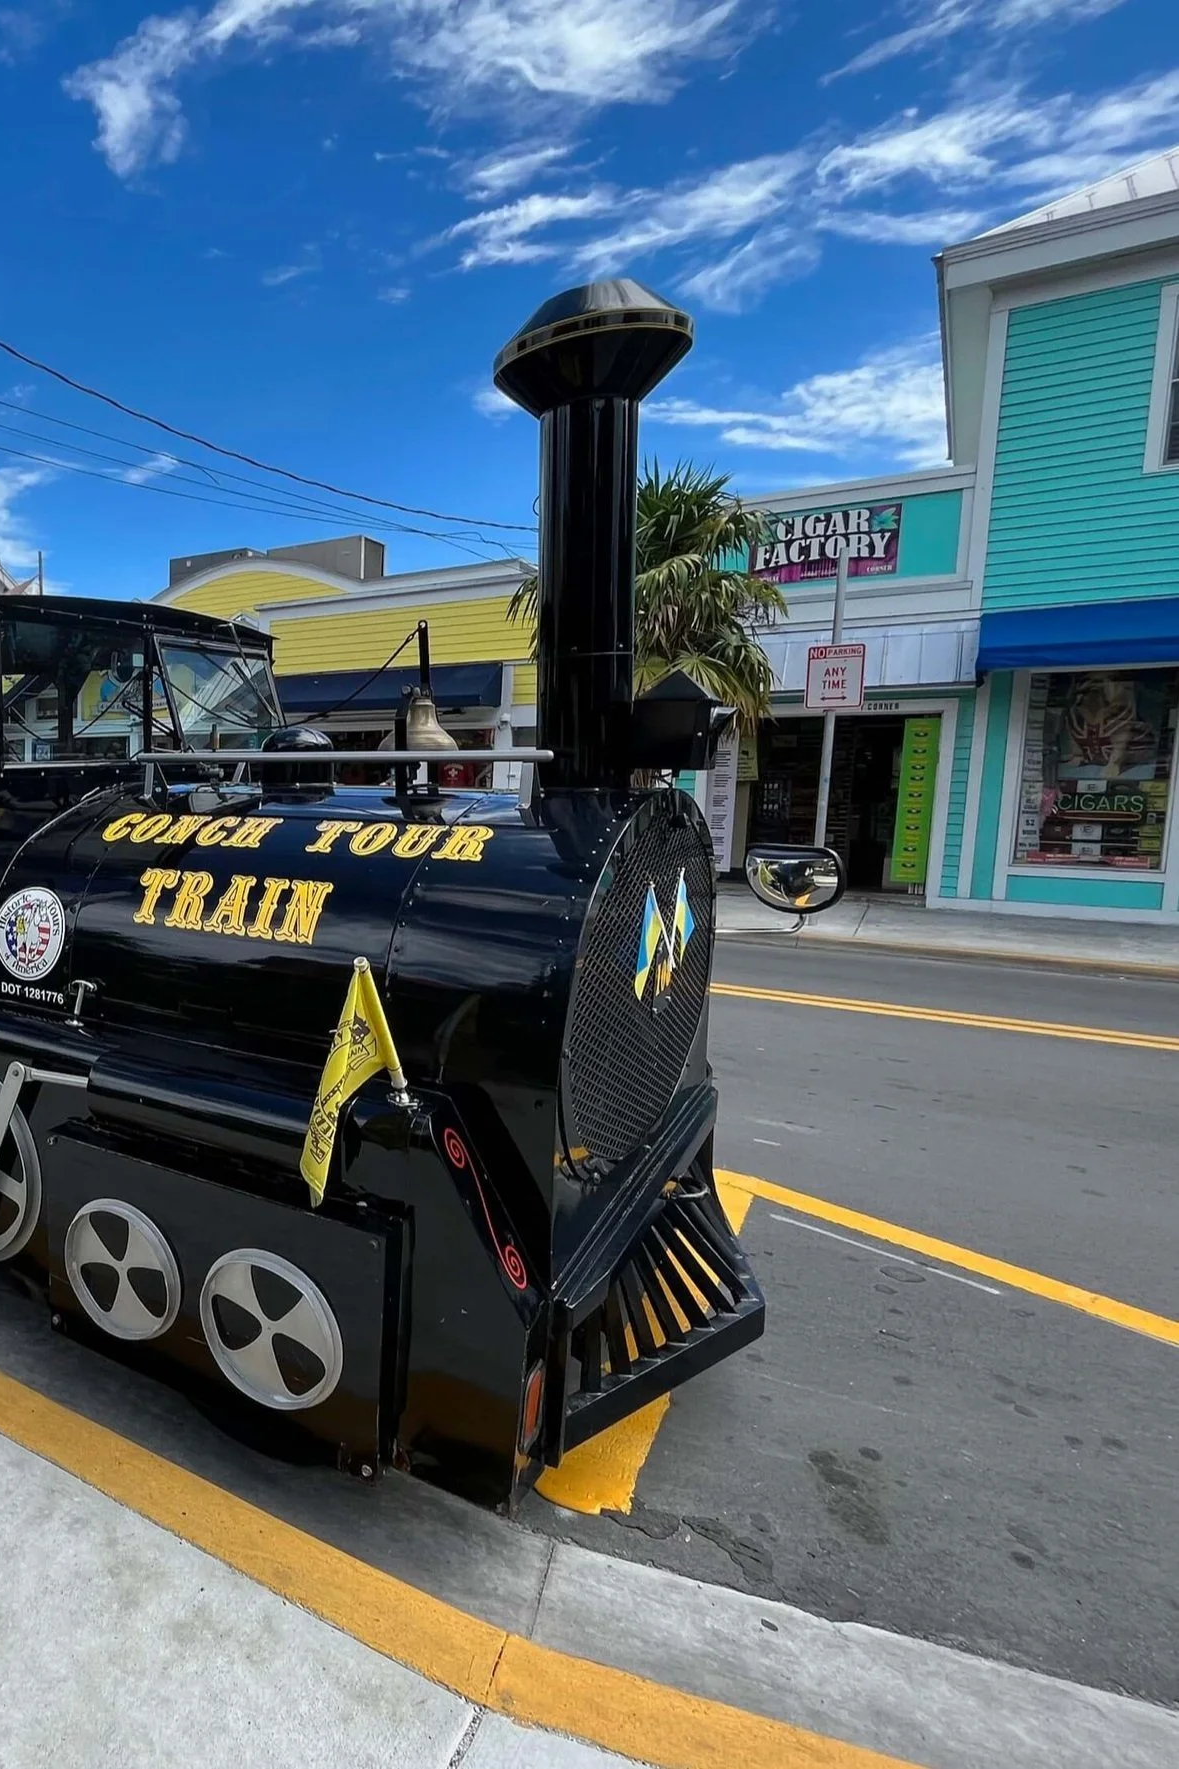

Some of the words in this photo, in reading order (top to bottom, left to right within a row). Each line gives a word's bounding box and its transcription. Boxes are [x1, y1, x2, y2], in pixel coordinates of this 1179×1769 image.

[776, 508, 870, 542] CIGAR
[753, 532, 891, 572] FACTORY
[810, 648, 826, 659] NO
[827, 647, 862, 657] PARKING
[824, 666, 847, 678] ANY
[821, 679, 847, 691] TIME
[867, 702, 900, 711] CORNER
[1058, 795, 1144, 813] CIGARS
[101, 813, 284, 848] CONCH
[304, 819, 495, 862] TOUR
[132, 867, 334, 945] TRAIN
[47, 900, 61, 937] Tours
[12, 959, 48, 975] America
[1, 982, 22, 995] DOT
[23, 986, 64, 1005] 1281776
